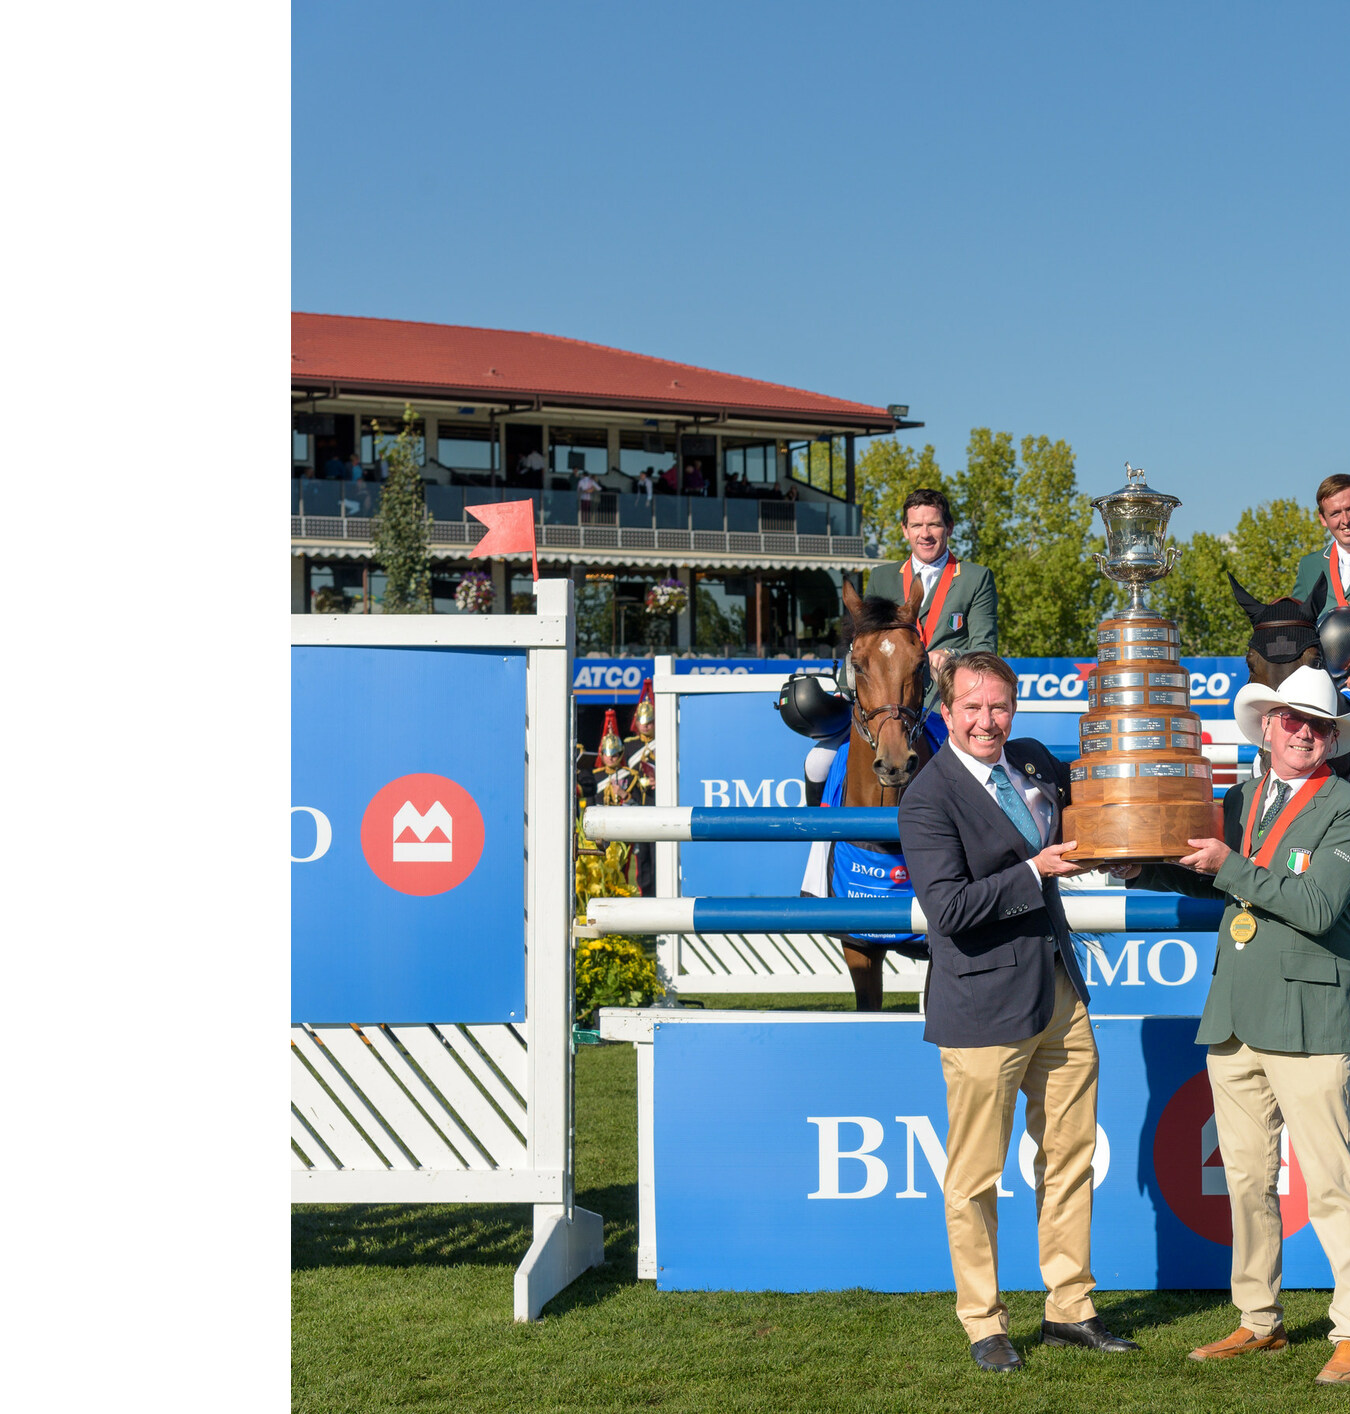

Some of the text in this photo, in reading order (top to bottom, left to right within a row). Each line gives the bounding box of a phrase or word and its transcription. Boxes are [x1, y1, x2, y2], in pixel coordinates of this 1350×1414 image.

[573, 666, 641, 688] ATCO
[1016, 673, 1084, 698] TCO
[851, 862, 886, 879] BMO
[1080, 939, 1198, 986] MO
